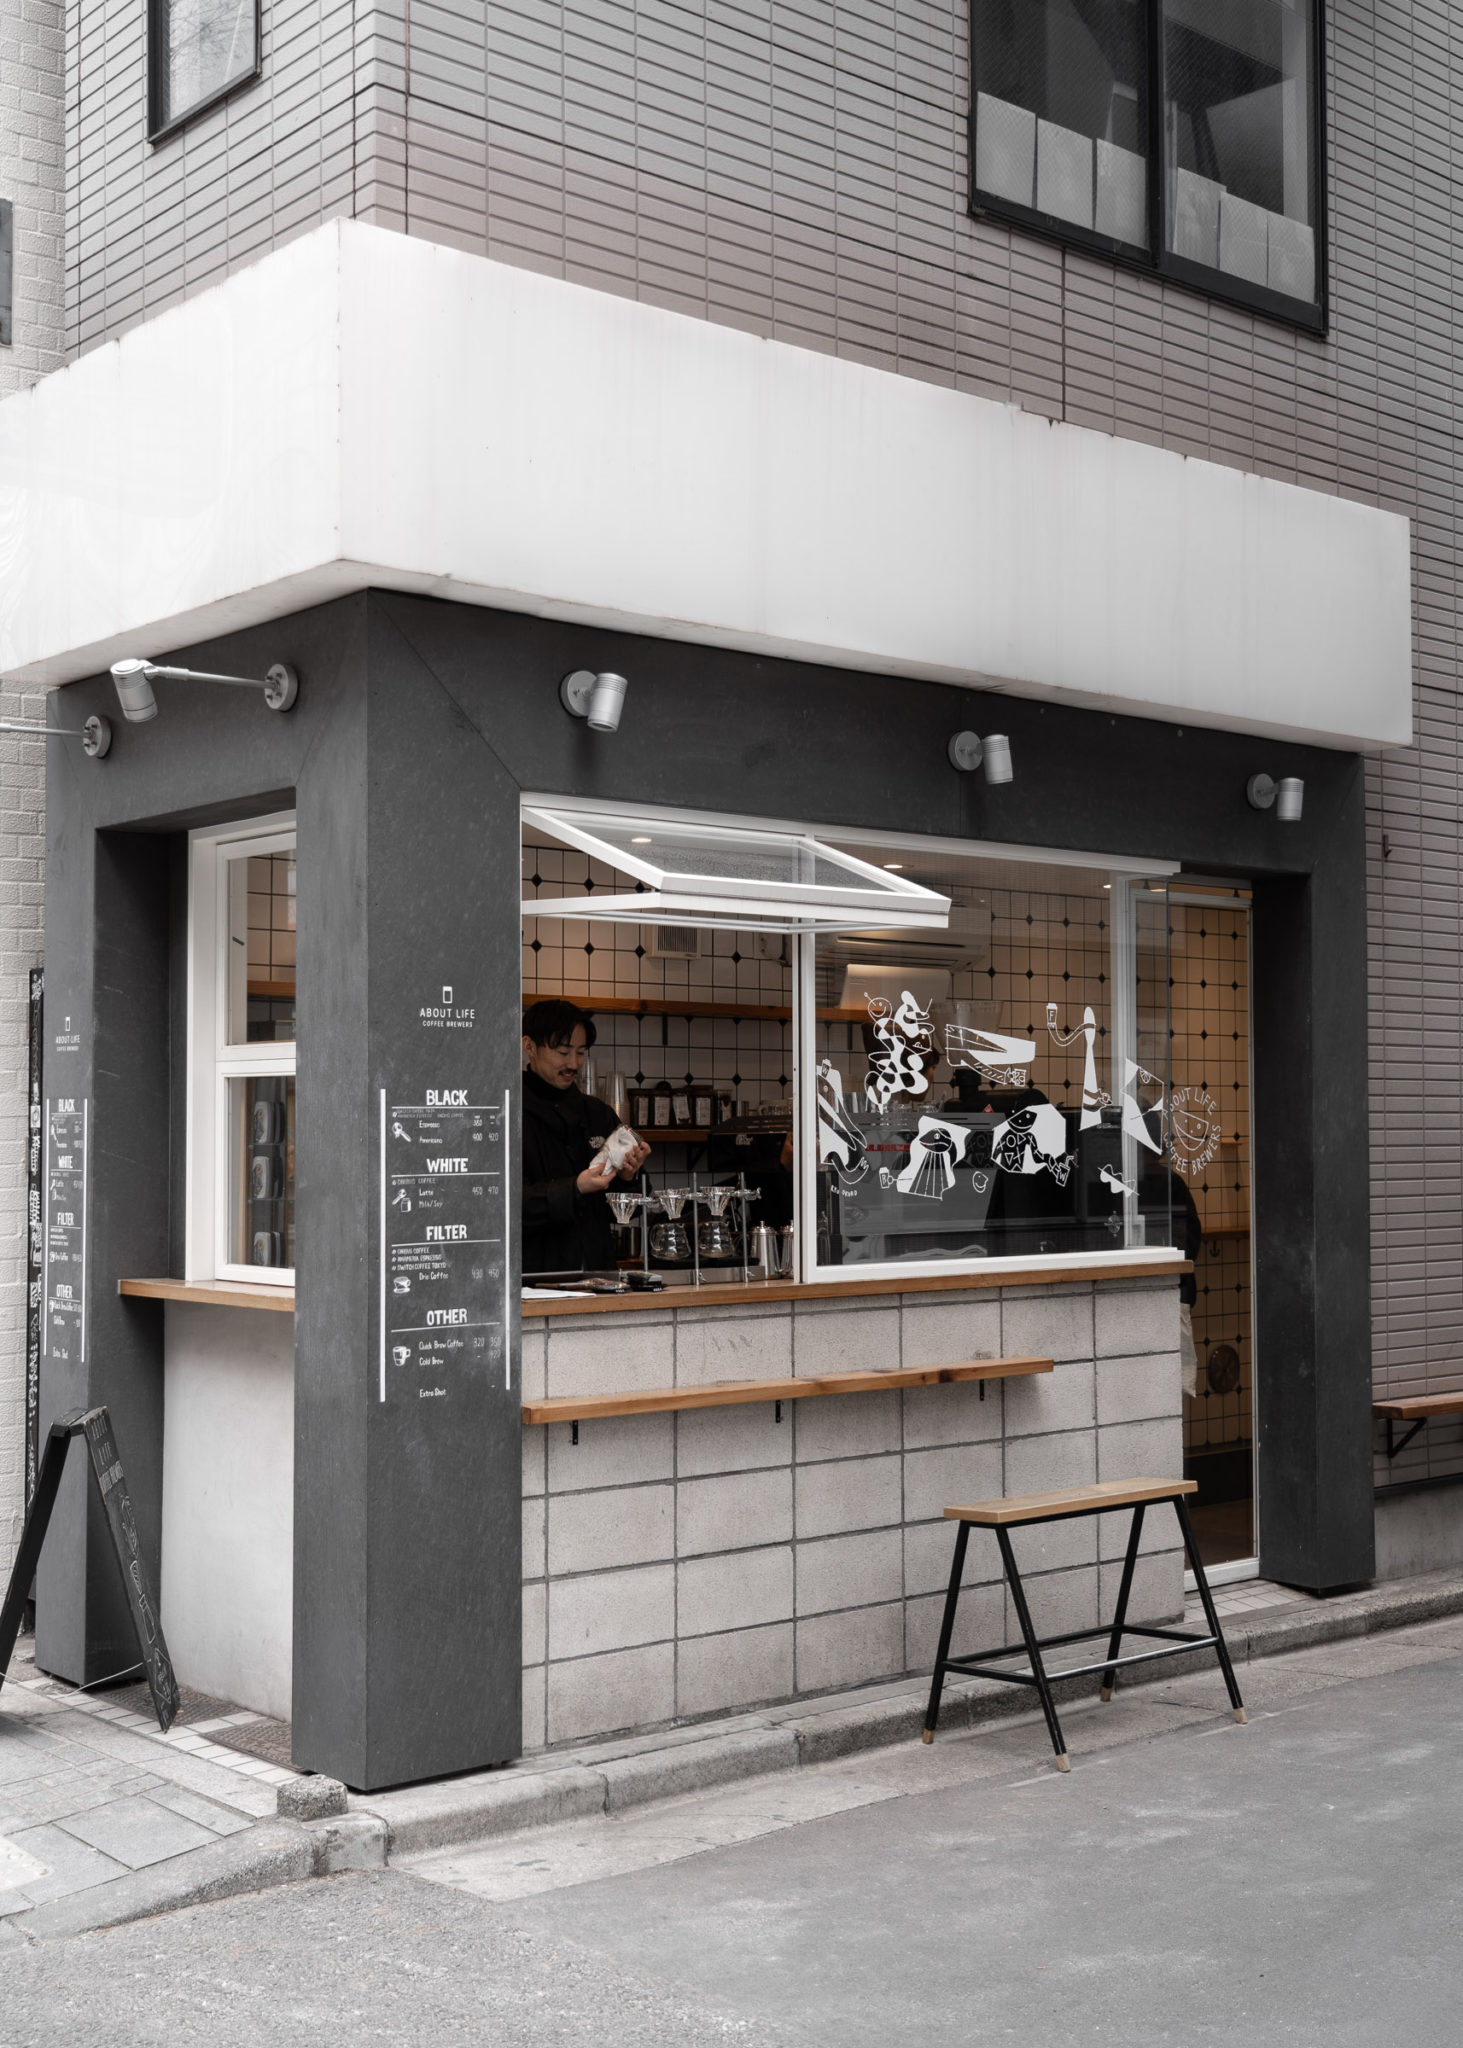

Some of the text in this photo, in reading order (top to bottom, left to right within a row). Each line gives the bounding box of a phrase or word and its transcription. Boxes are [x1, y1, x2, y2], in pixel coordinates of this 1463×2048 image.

[419, 1008, 475, 1019] ABOUT LIFE
[56, 1034, 80, 1044] ABOUT LIFE
[426, 1089, 469, 1106] BLACK
[1194, 1087, 1217, 1116] LIFE
[58, 1099, 75, 1112] BLACK
[1191, 1125, 1222, 1176] BREWERS
[58, 1156, 73, 1168] WHITE
[426, 1158, 469, 1173] WHITE
[419, 1188, 434, 1197] Latte
[57, 1212, 75, 1226] FILTER
[426, 1225, 468, 1241] FILTER
[56, 1284, 72, 1298] OTHER
[426, 1308, 468, 1326] OTHER
[419, 1357, 431, 1366] Cold
[432, 1357, 444, 1366] Brew
[419, 1388, 447, 1398] Extra Shot
